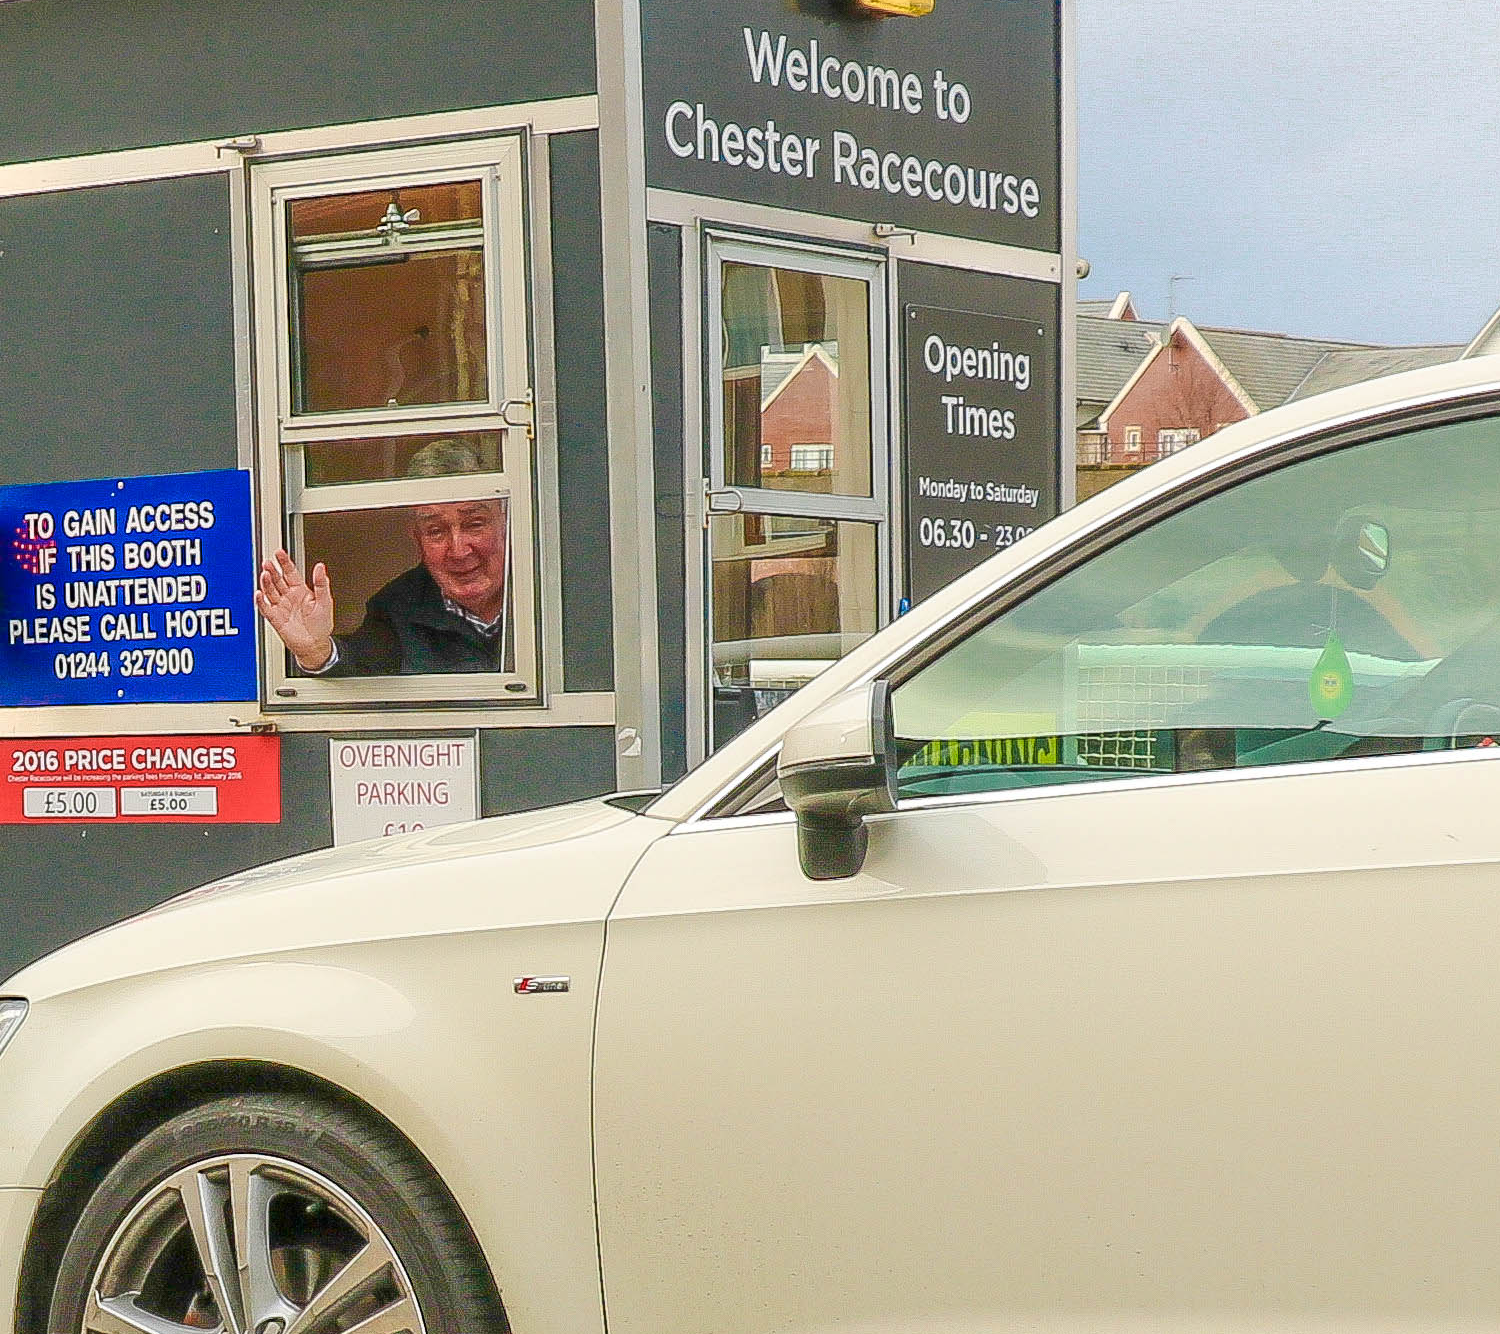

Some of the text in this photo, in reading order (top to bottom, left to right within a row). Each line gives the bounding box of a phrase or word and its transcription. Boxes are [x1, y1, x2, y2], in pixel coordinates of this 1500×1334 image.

[743, 27, 972, 125] Welcome to
[664, 101, 1041, 218] Chester Racecourse
[924, 335, 1031, 390] Opening
[941, 395, 1016, 440] Times
[918, 476, 1039, 508] Monday to Saturday
[24, 501, 214, 540] TO GAIN ACCESS
[919, 517, 975, 549] 06.30
[38, 538, 201, 574] IF THIS BOOTH
[36, 575, 207, 610] IS UNATTENDED
[9, 608, 239, 645] PLEASE CALL HOTEL
[54, 647, 194, 679] 01244 327900
[12, 747, 236, 772] 2016 PRICE CHANGES
[339, 743, 465, 768] OVERNIGHT
[44, 790, 97, 814] £5.00
[150, 798, 188, 811] £5.00
[357, 782, 449, 805] PARKING
